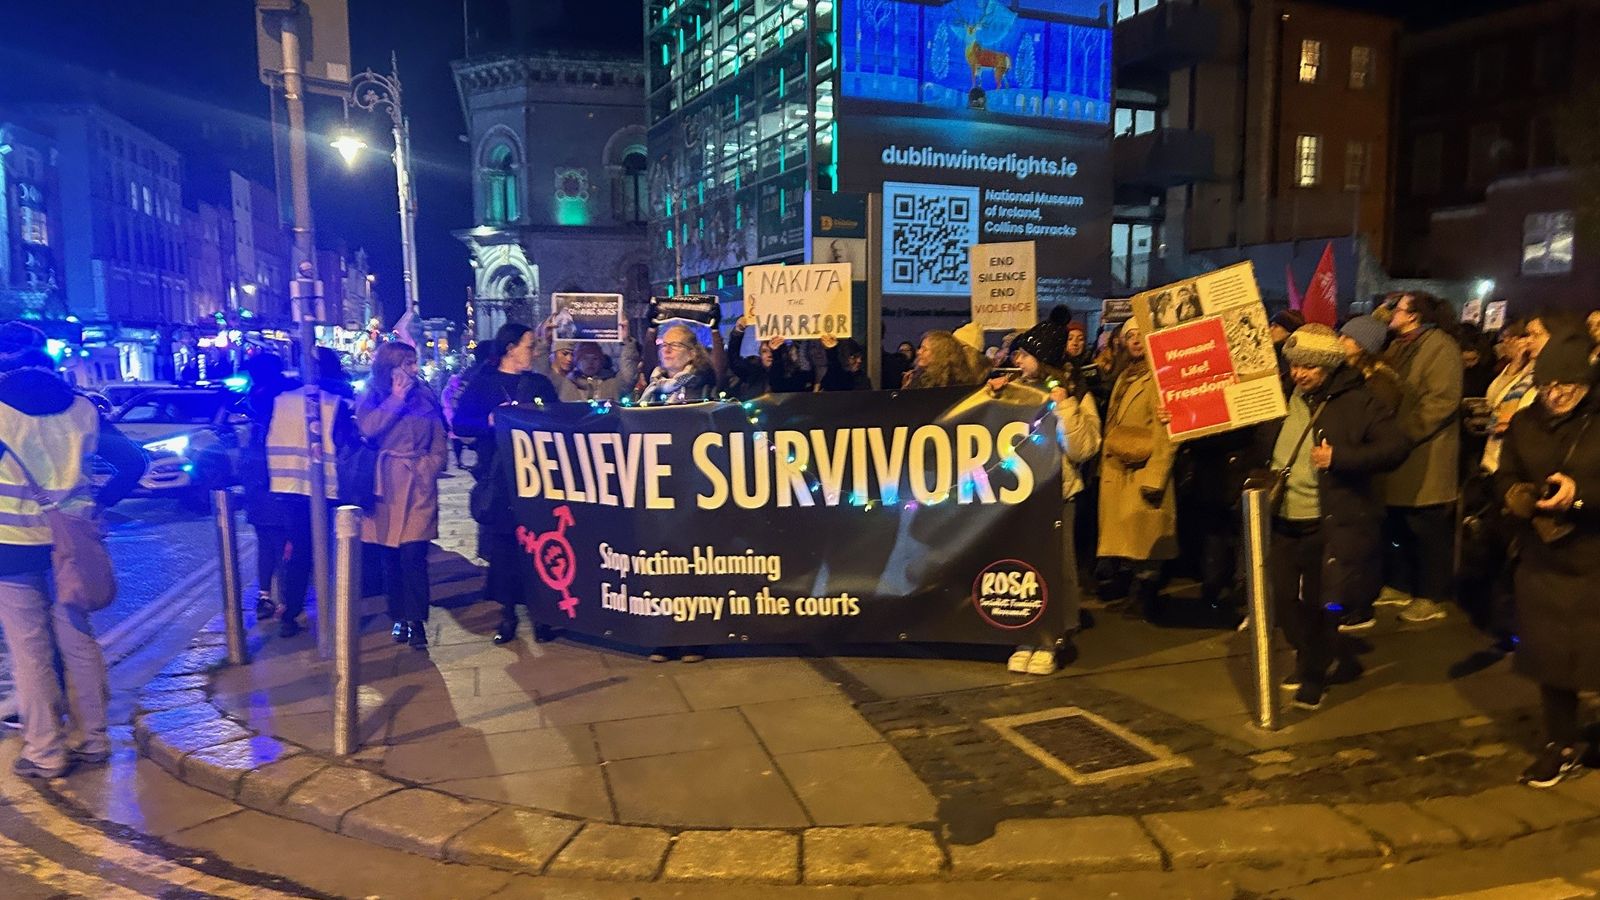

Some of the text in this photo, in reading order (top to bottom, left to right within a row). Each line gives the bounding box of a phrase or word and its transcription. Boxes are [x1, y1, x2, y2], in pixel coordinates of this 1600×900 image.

[881, 145, 1078, 180] dublinwinterlights.ie
[984, 189, 1084, 207] National Museum
[984, 205, 1043, 220] of Ireland,
[984, 221, 1078, 237] Collins Barracks
[990, 256, 1015, 267] END
[760, 269, 843, 294] NAKITA
[978, 271, 1027, 283] SILENCE
[990, 287, 1015, 298] END
[787, 298, 805, 306] THE
[974, 302, 1032, 314] VIOLENCE
[756, 313, 848, 337] WARRIOR
[1180, 360, 1211, 379] Life!
[511, 421, 1035, 510] BELIEVE SURVIVORS
[599, 542, 781, 581] Stop victim-blaming
[981, 571, 1039, 599] ROSA
[601, 582, 861, 622] End misogyny in the courts
